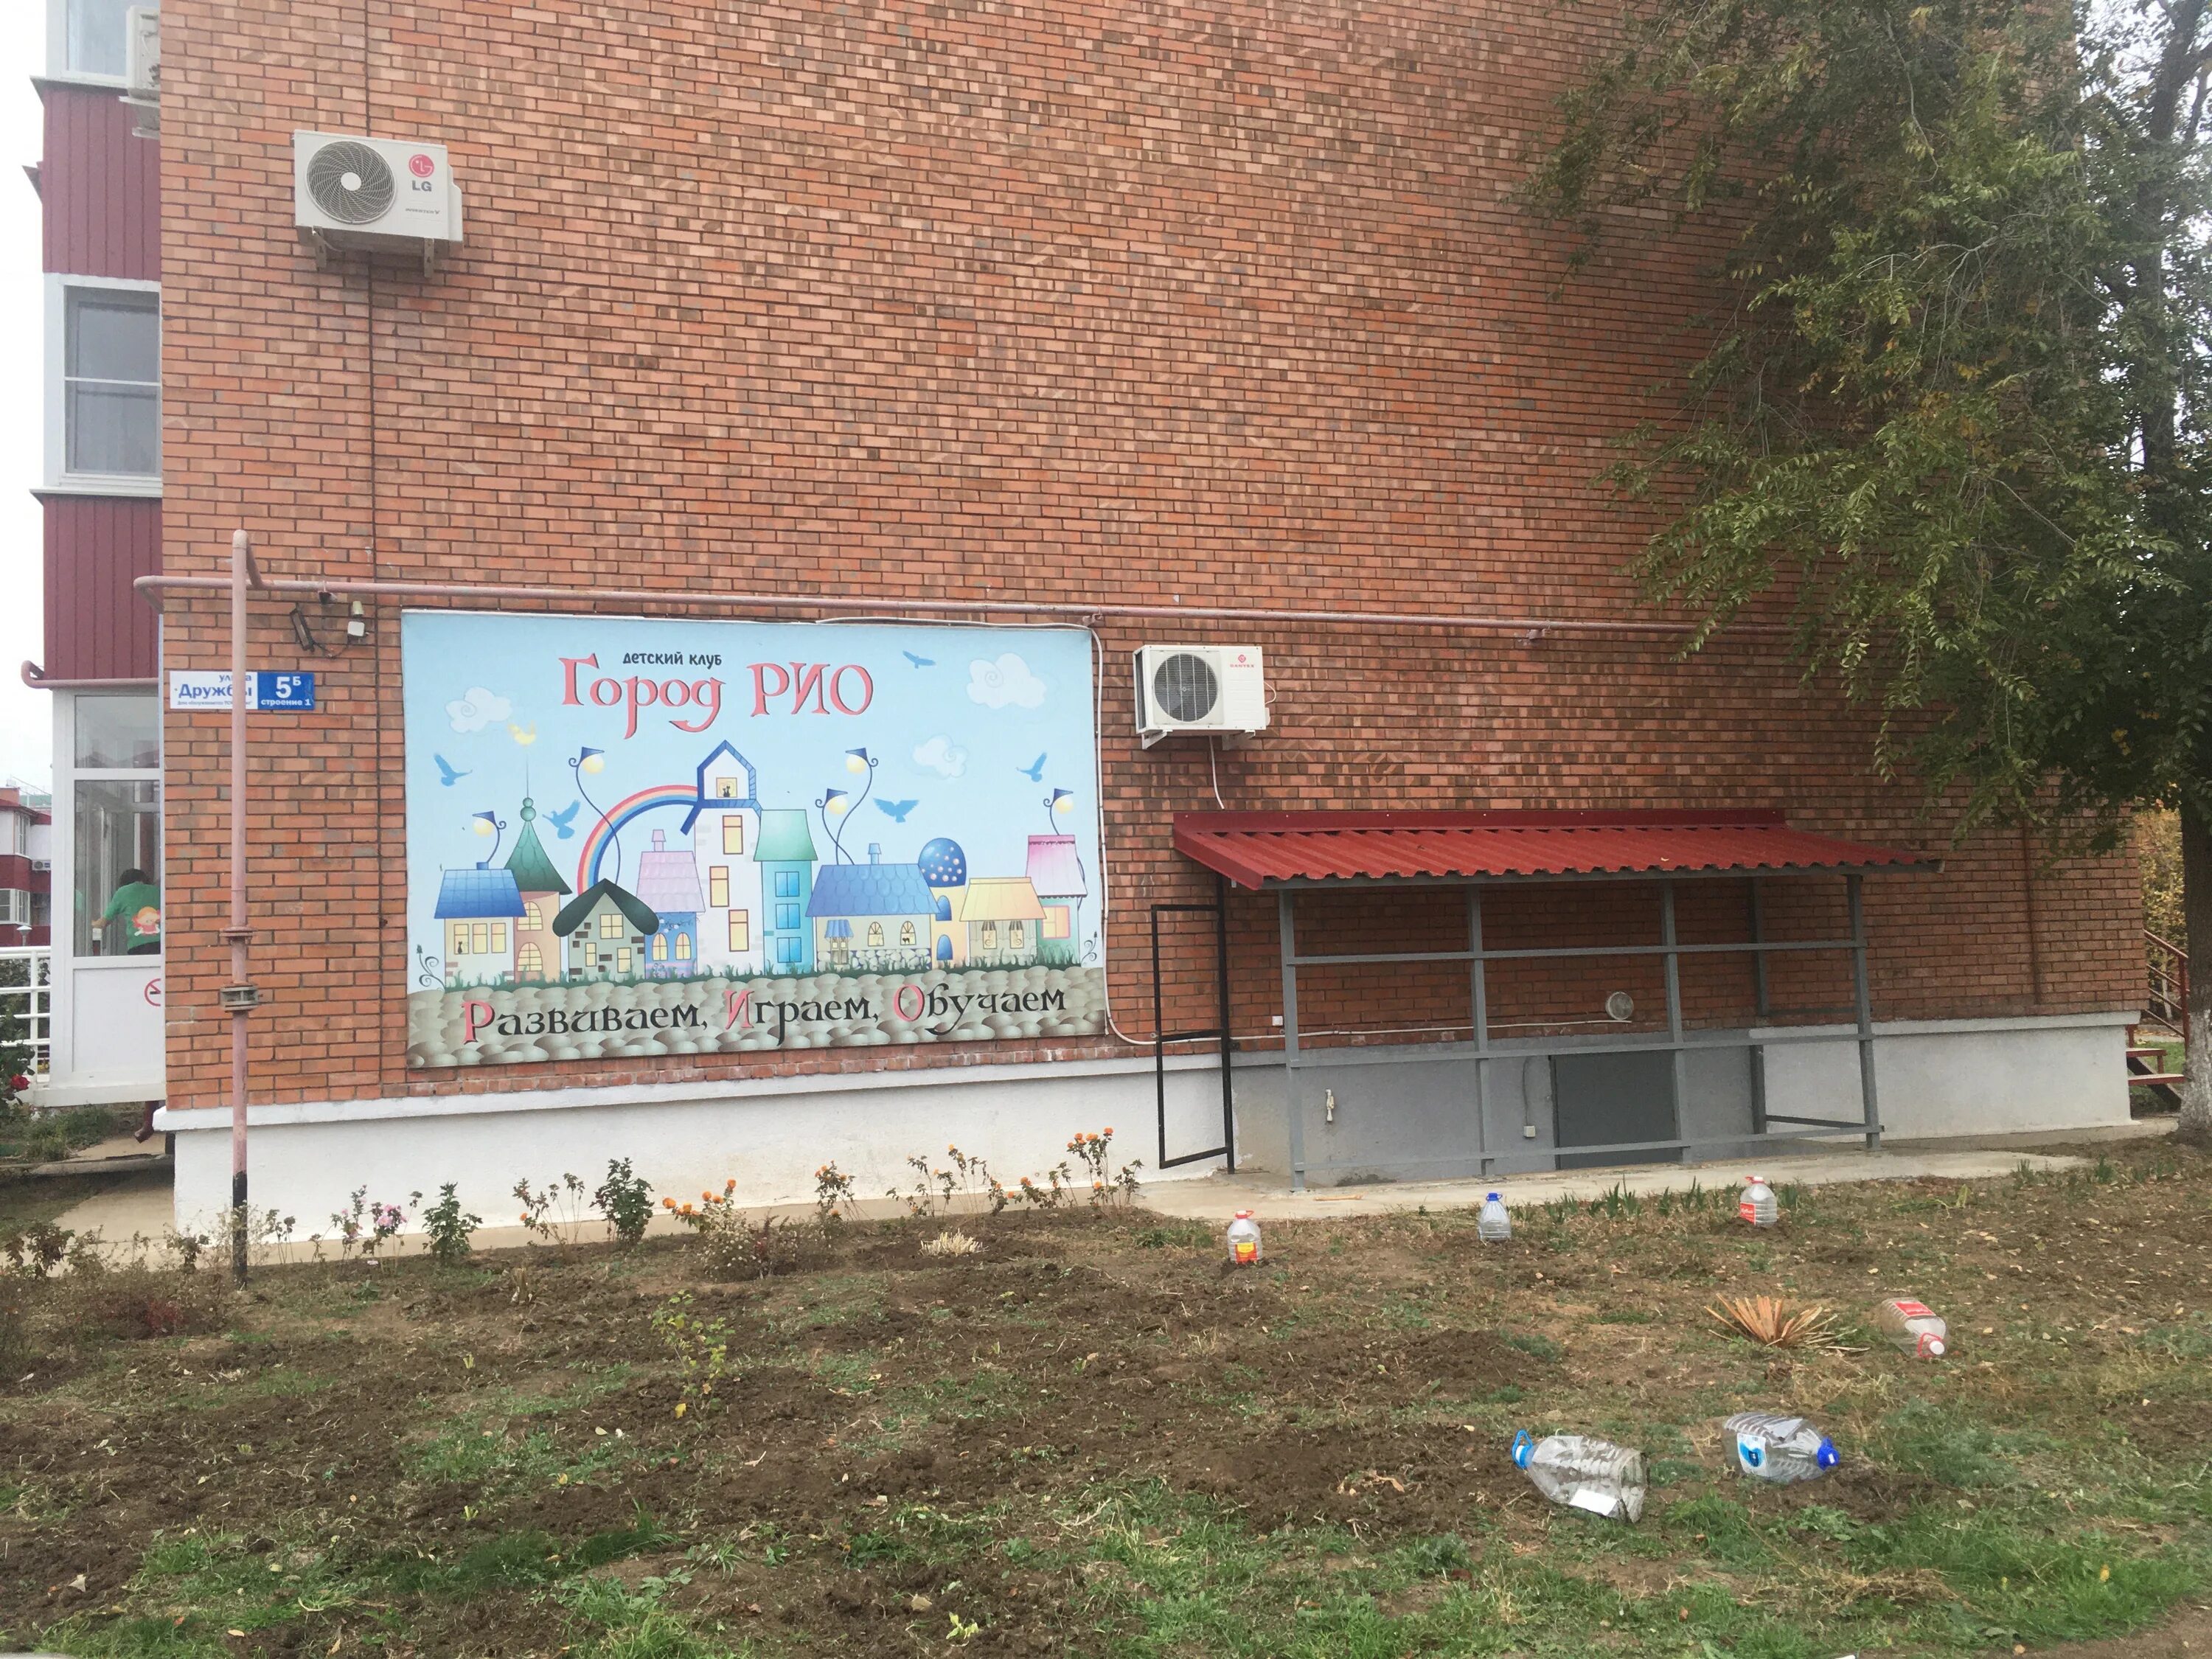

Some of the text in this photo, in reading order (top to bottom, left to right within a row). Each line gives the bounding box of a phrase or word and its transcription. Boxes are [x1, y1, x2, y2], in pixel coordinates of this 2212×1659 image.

[412, 180, 432, 192] LG
[623, 652, 722, 669] детский клуб
[219, 675, 251, 683] ула
[261, 699, 302, 708] строение
[559, 653, 874, 740] Город РИО
[461, 983, 1065, 1046] Развиваем, Играем, Обучаем
